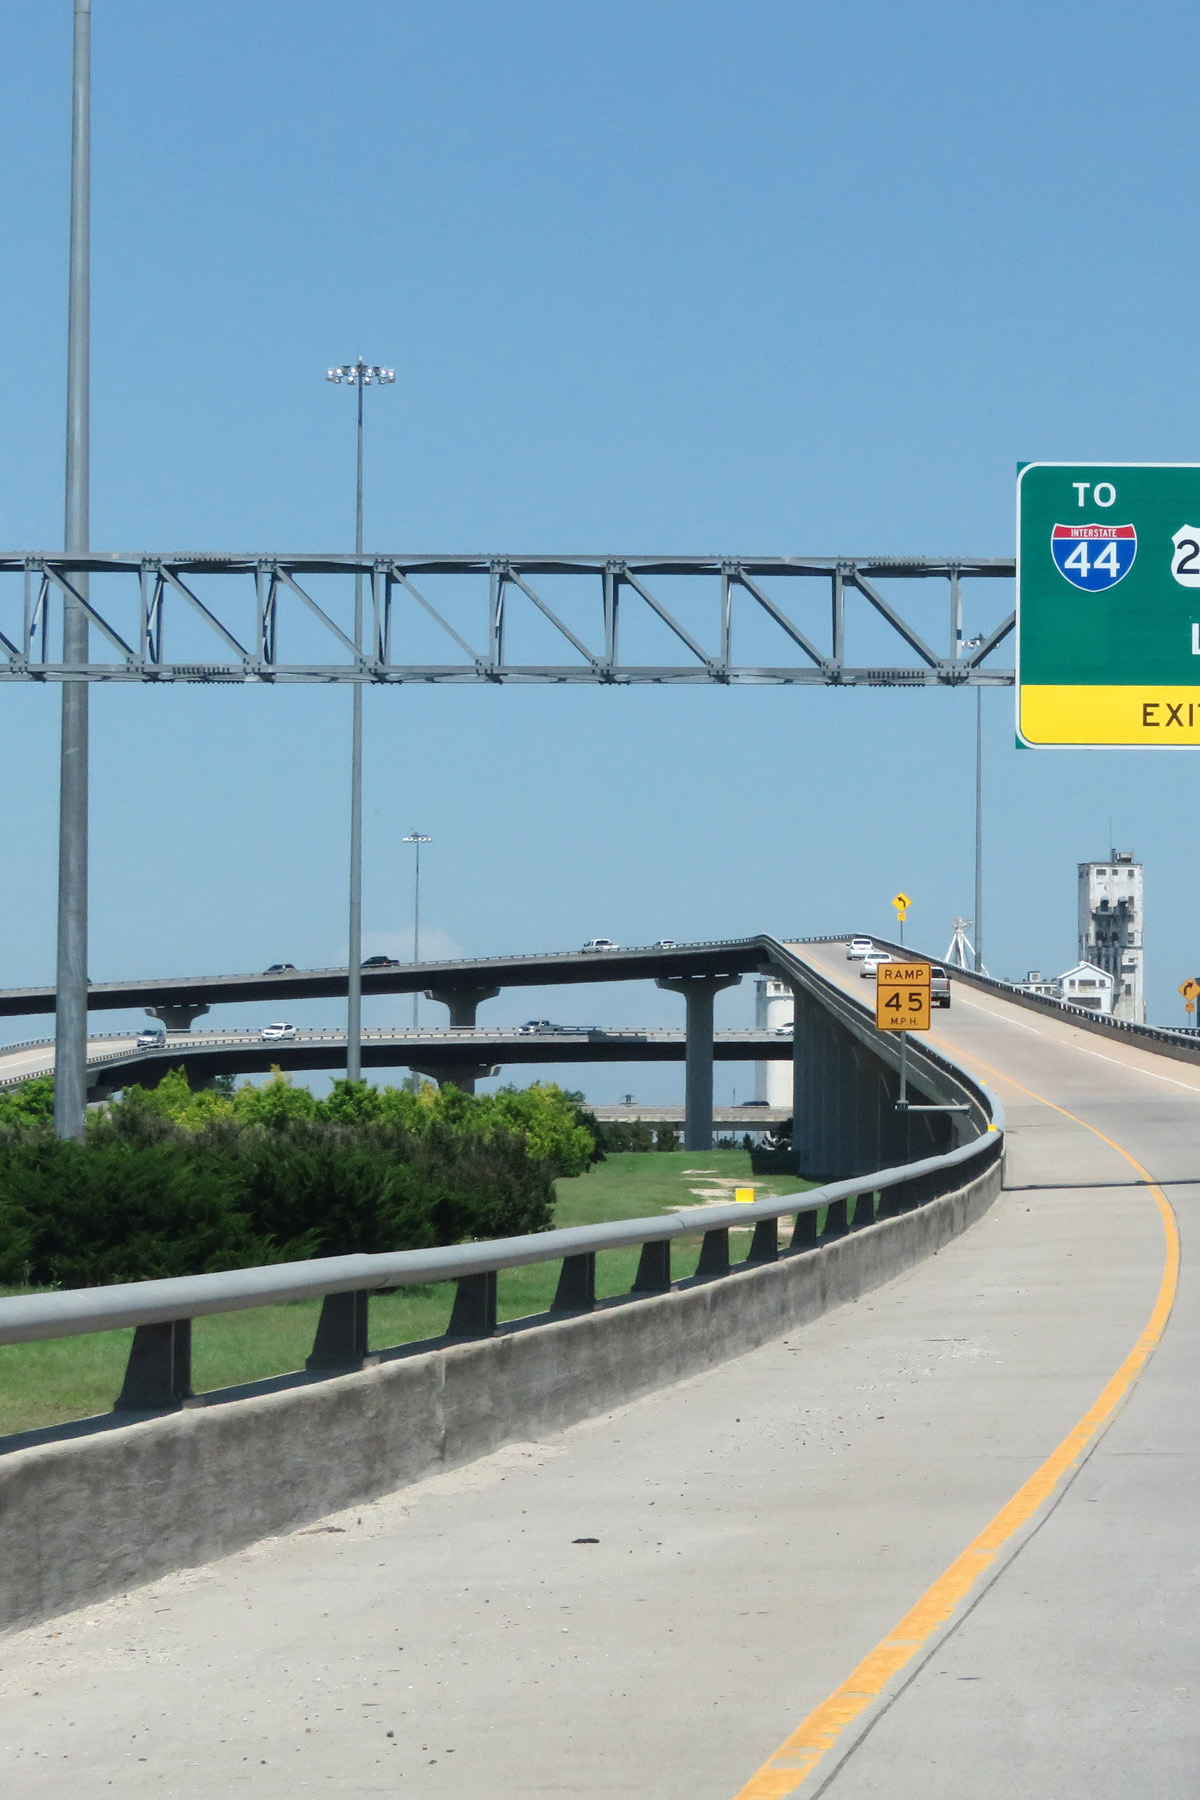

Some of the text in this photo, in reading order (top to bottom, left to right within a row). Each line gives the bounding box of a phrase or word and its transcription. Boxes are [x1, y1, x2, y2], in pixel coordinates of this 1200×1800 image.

[1072, 482, 1117, 507] TO
[1071, 528, 1118, 538] INTERSTATE
[1064, 541, 1121, 578] 44
[885, 970, 923, 979] RAMP
[885, 993, 922, 1011] 45
